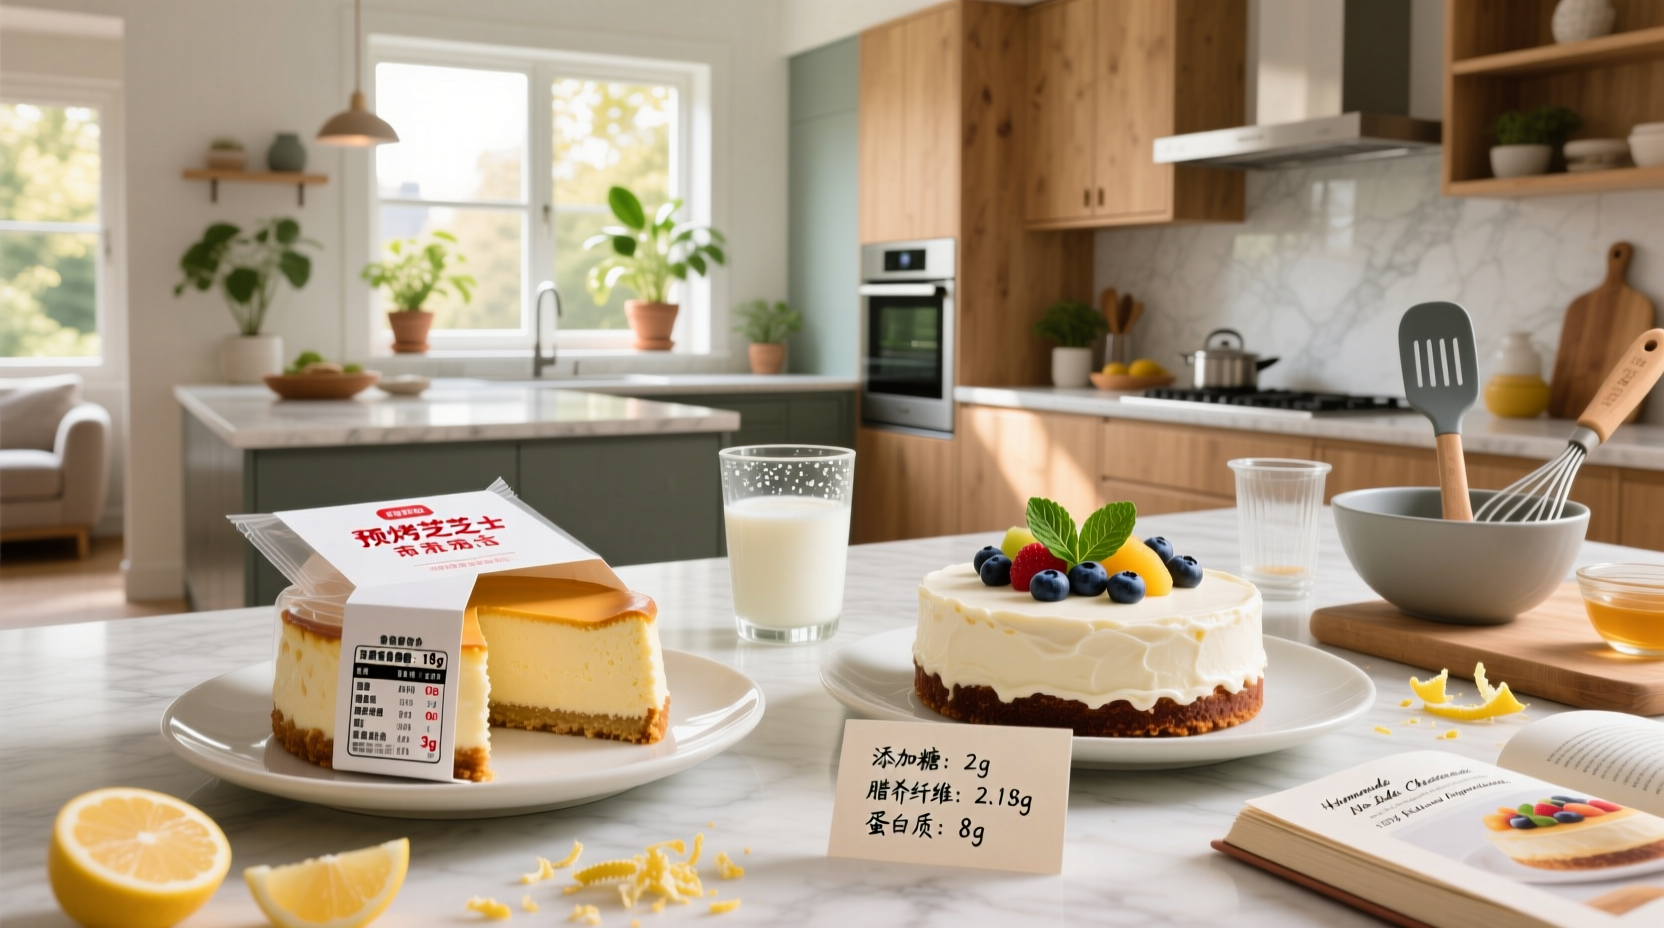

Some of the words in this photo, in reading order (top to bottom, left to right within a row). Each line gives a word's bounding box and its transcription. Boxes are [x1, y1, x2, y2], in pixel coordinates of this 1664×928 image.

[423, 653, 445, 668] 18g
[420, 735, 437, 752] 3g
[963, 753, 990, 778] 2g
[959, 817, 985, 847] 8g
